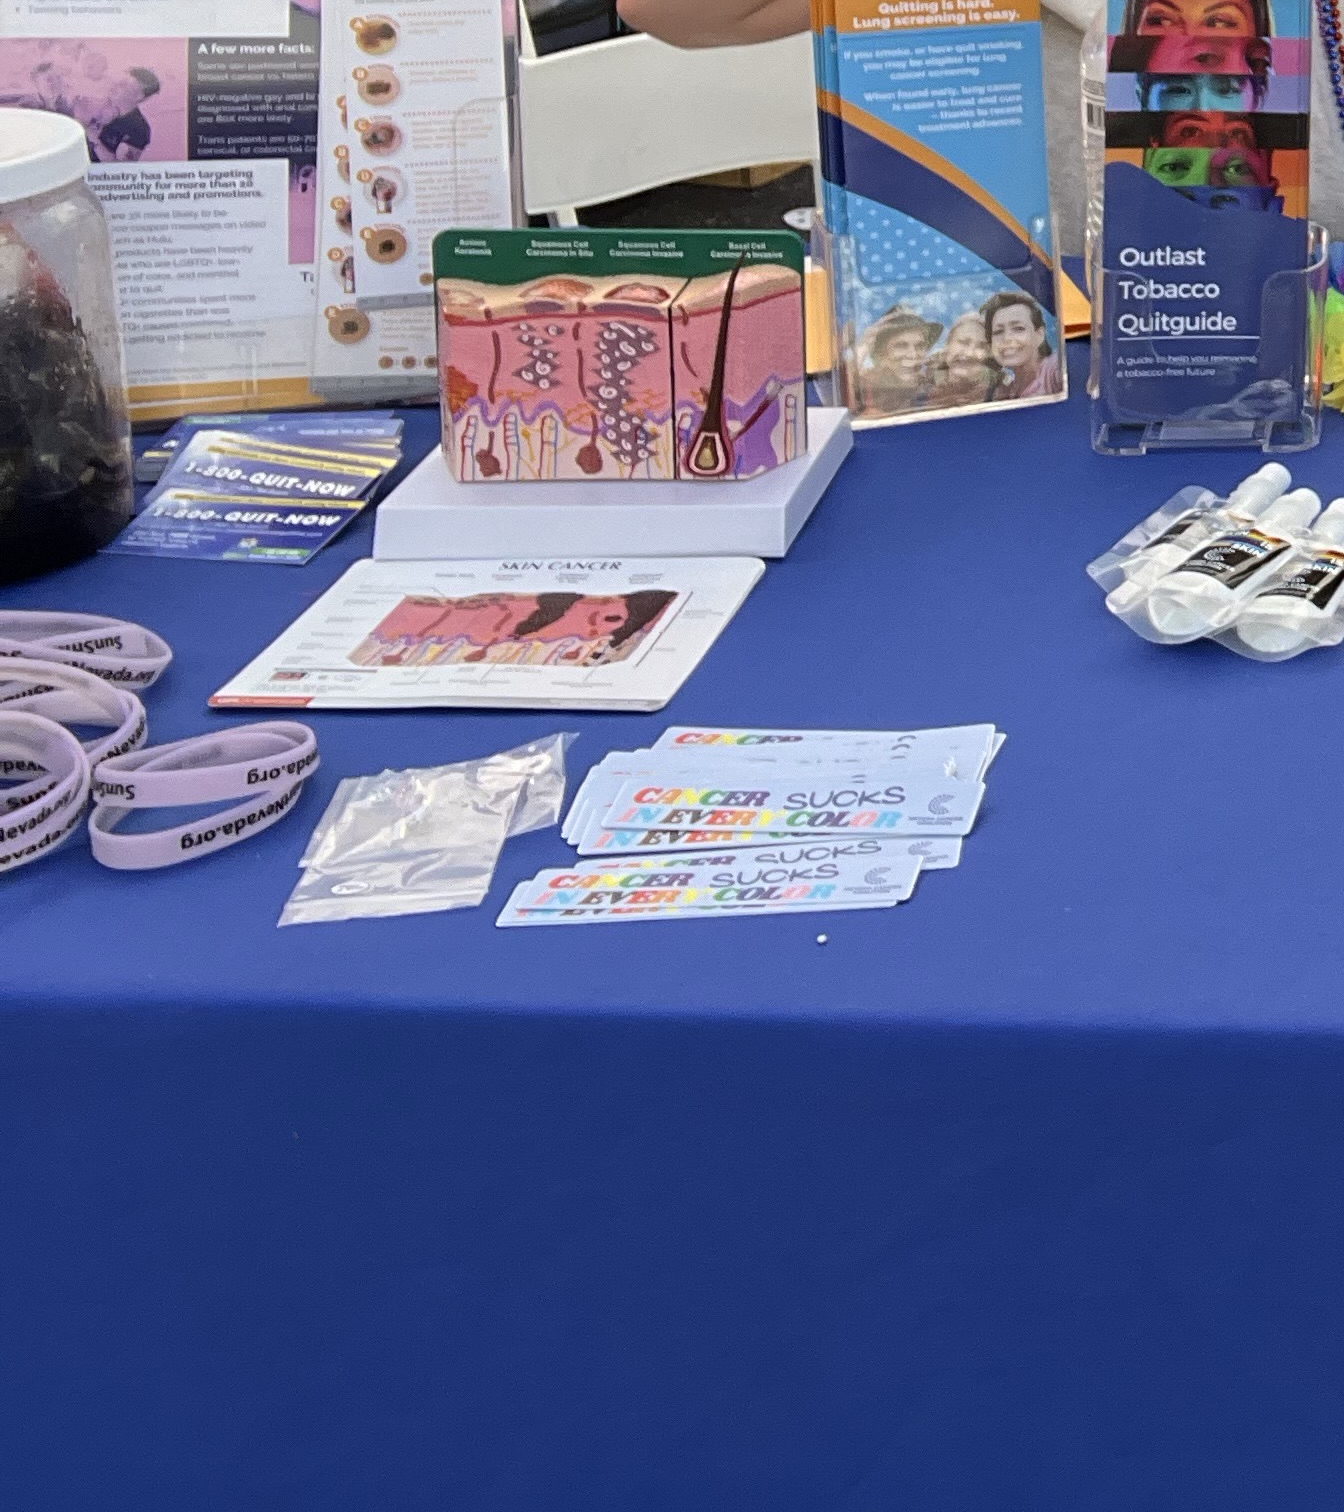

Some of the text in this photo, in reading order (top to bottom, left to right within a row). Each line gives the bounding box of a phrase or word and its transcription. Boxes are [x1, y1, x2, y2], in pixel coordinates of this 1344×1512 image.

[878, 0, 939, 15] Quitting
[941, 0, 954, 11] is
[852, 9, 1021, 30] Lung screening is easy.
[197, 42, 208, 55] A
[211, 41, 237, 55] few
[240, 43, 275, 55] more
[1119, 245, 1206, 267] Outlast
[1118, 278, 1221, 300] Tobacco
[1117, 311, 1238, 336] Quitguide
[184, 460, 356, 498] 1-800-QUIT-NOW
[152, 505, 342, 527] 1-800-QUIT-NOW
[499, 561, 622, 571] SKIN CANCER
[633, 785, 906, 811] CANCER SUCKS
[618, 808, 661, 825] IN
[658, 808, 785, 827] EVERY
[785, 809, 902, 828] COLOR
[754, 839, 883, 864] SUCKS
[547, 864, 840, 890] CANCER SUCKS
[534, 883, 838, 906] IN EVERY COLOR
